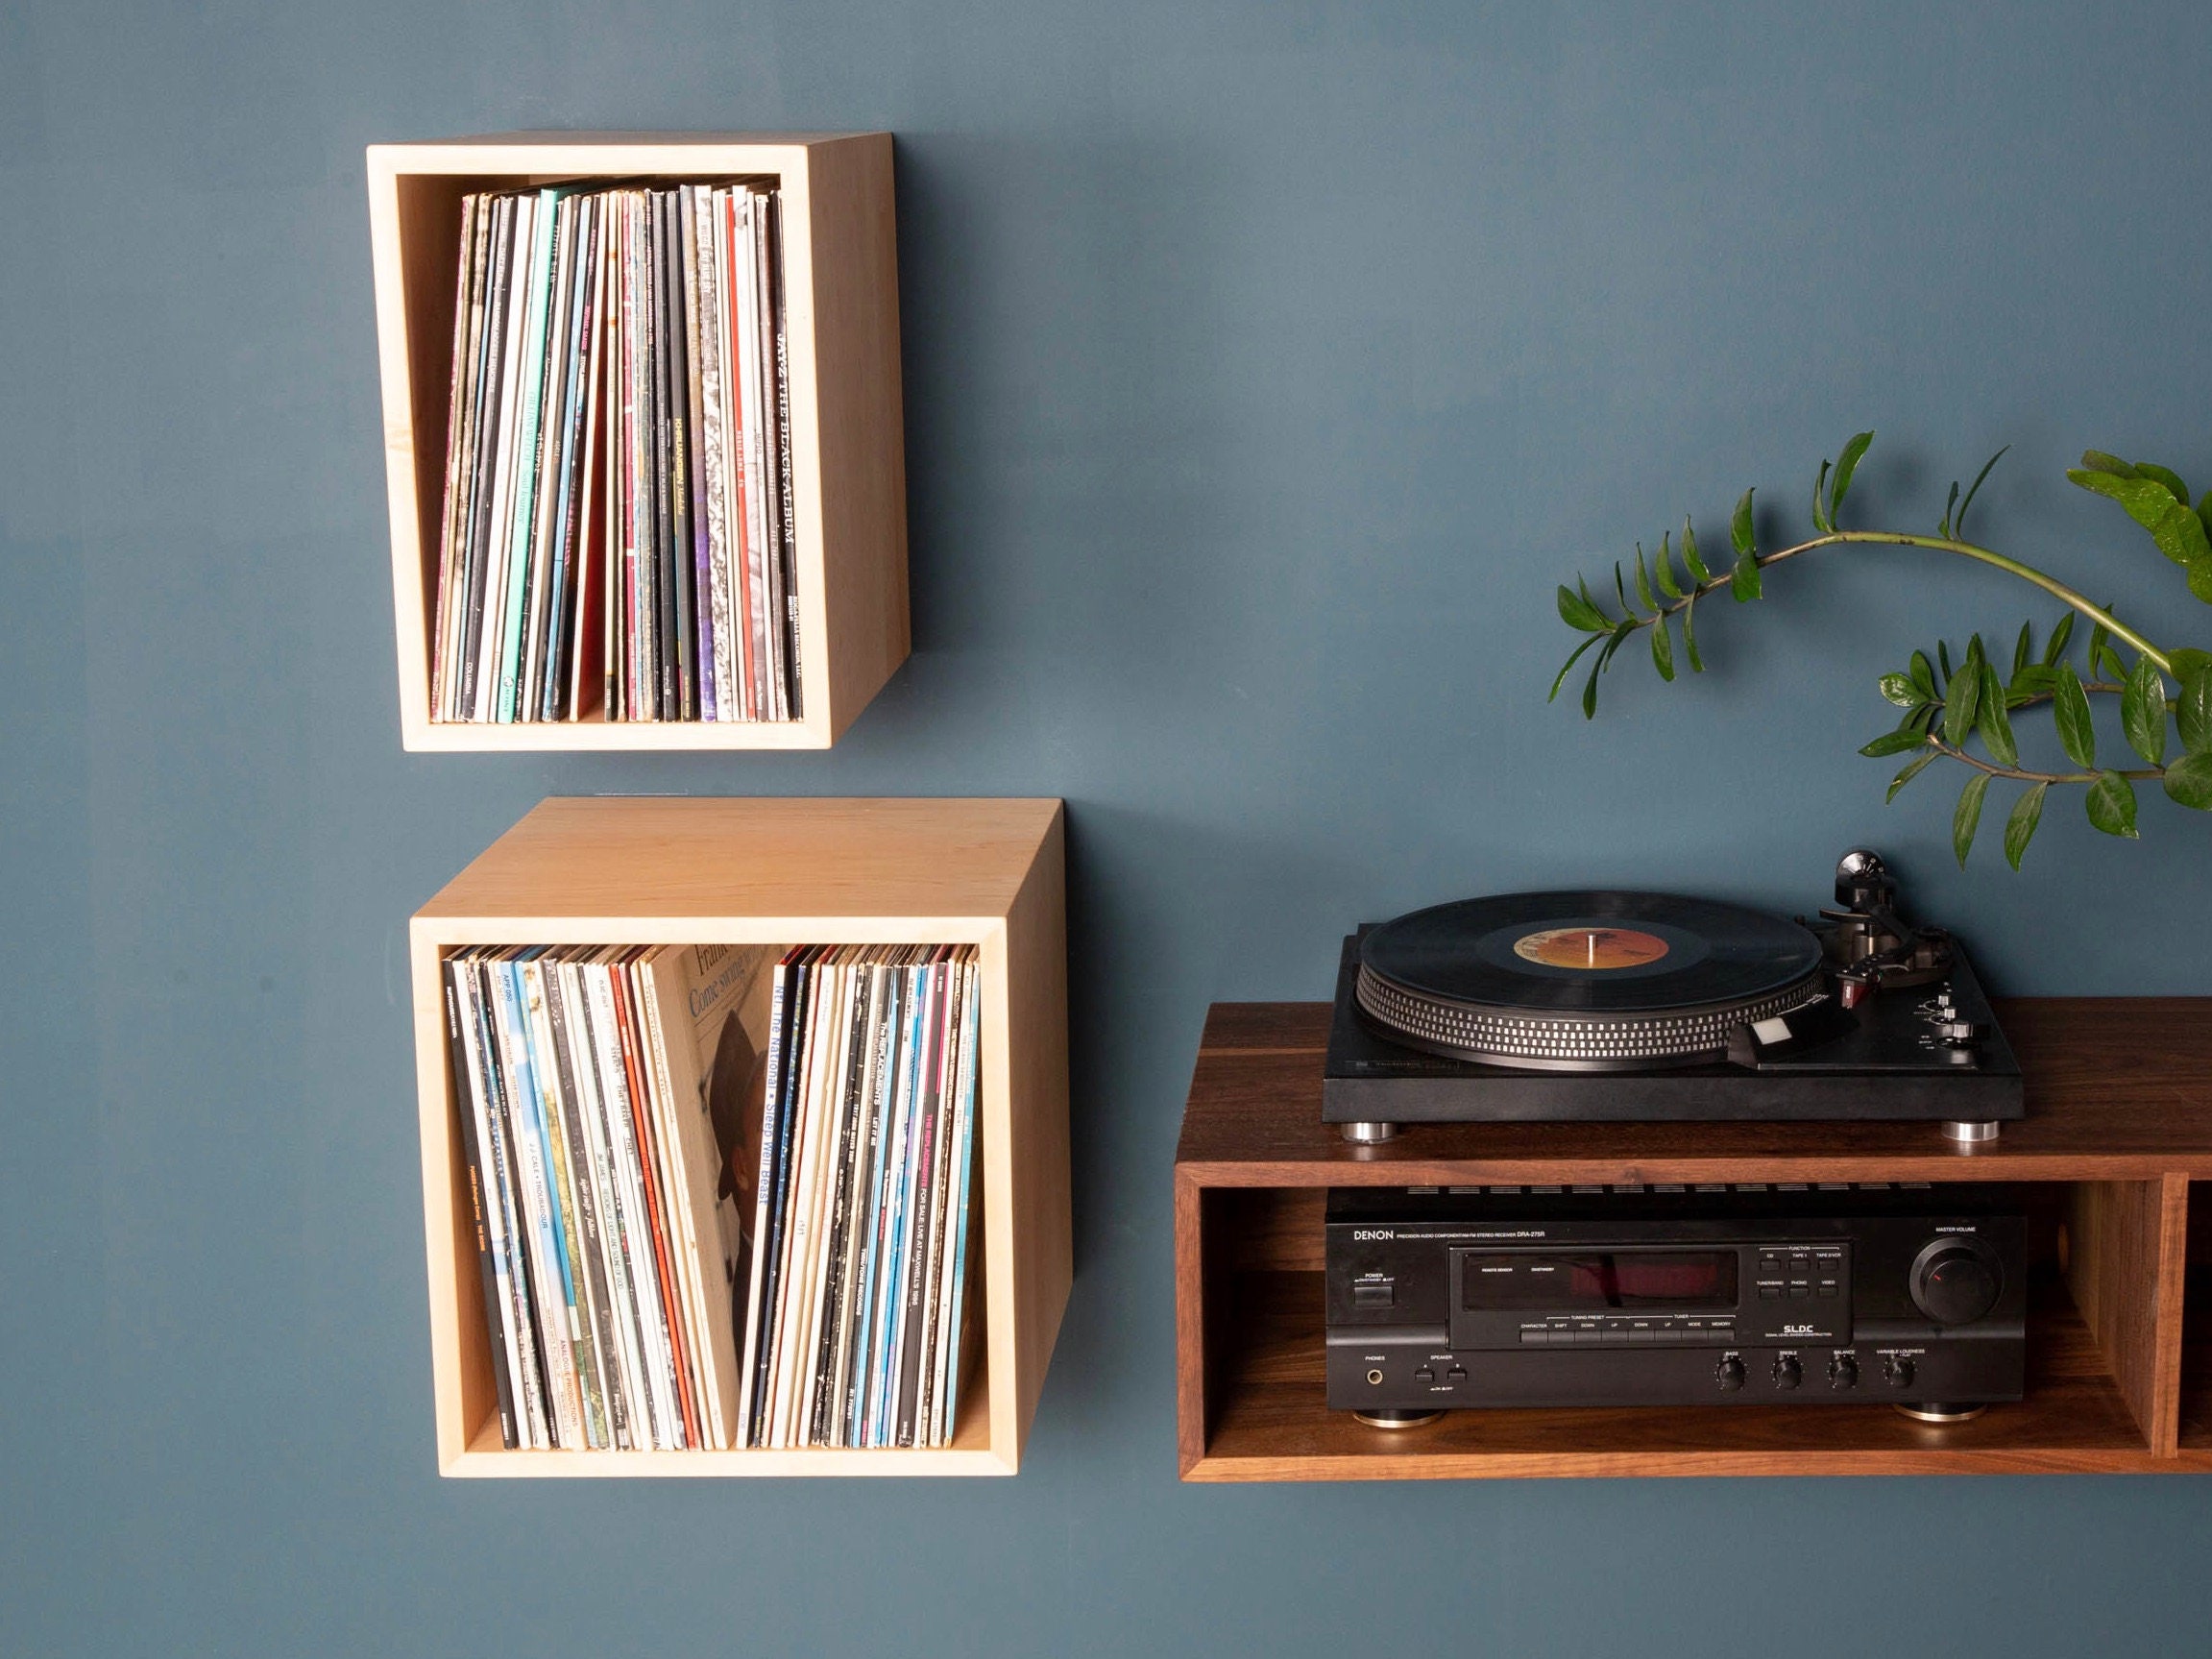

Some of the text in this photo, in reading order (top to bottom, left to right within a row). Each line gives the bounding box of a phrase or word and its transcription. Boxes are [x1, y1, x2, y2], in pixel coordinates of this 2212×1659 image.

[524, 391, 536, 427] GILLIAN
[778, 380, 789, 416] THE
[523, 428, 533, 461] WELCH
[673, 417, 684, 483] KHRUANGBIN
[779, 421, 790, 478] BLACK
[783, 481, 793, 543] ALBUM
[463, 661, 474, 695] COLUMBIA
[502, 973, 511, 988] APP
[689, 981, 718, 1018] Come
[771, 1012, 781, 1033] The
[767, 1037, 780, 1088] National
[762, 1103, 776, 1137] Sleep
[530, 1155, 540, 1174] CALE
[761, 1140, 773, 1165] Well
[920, 1130, 932, 1188] REPLACEMENTS
[533, 1180, 550, 1229] TROUBADOUR
[758, 1169, 771, 1205] Beast
[915, 1239, 922, 1250] AT
[1354, 1231, 1394, 1240] DENON
[912, 1250, 922, 1289] MAXWELL'S
[559, 1338, 579, 1427] ANALOGUE PRODUCTIONS
